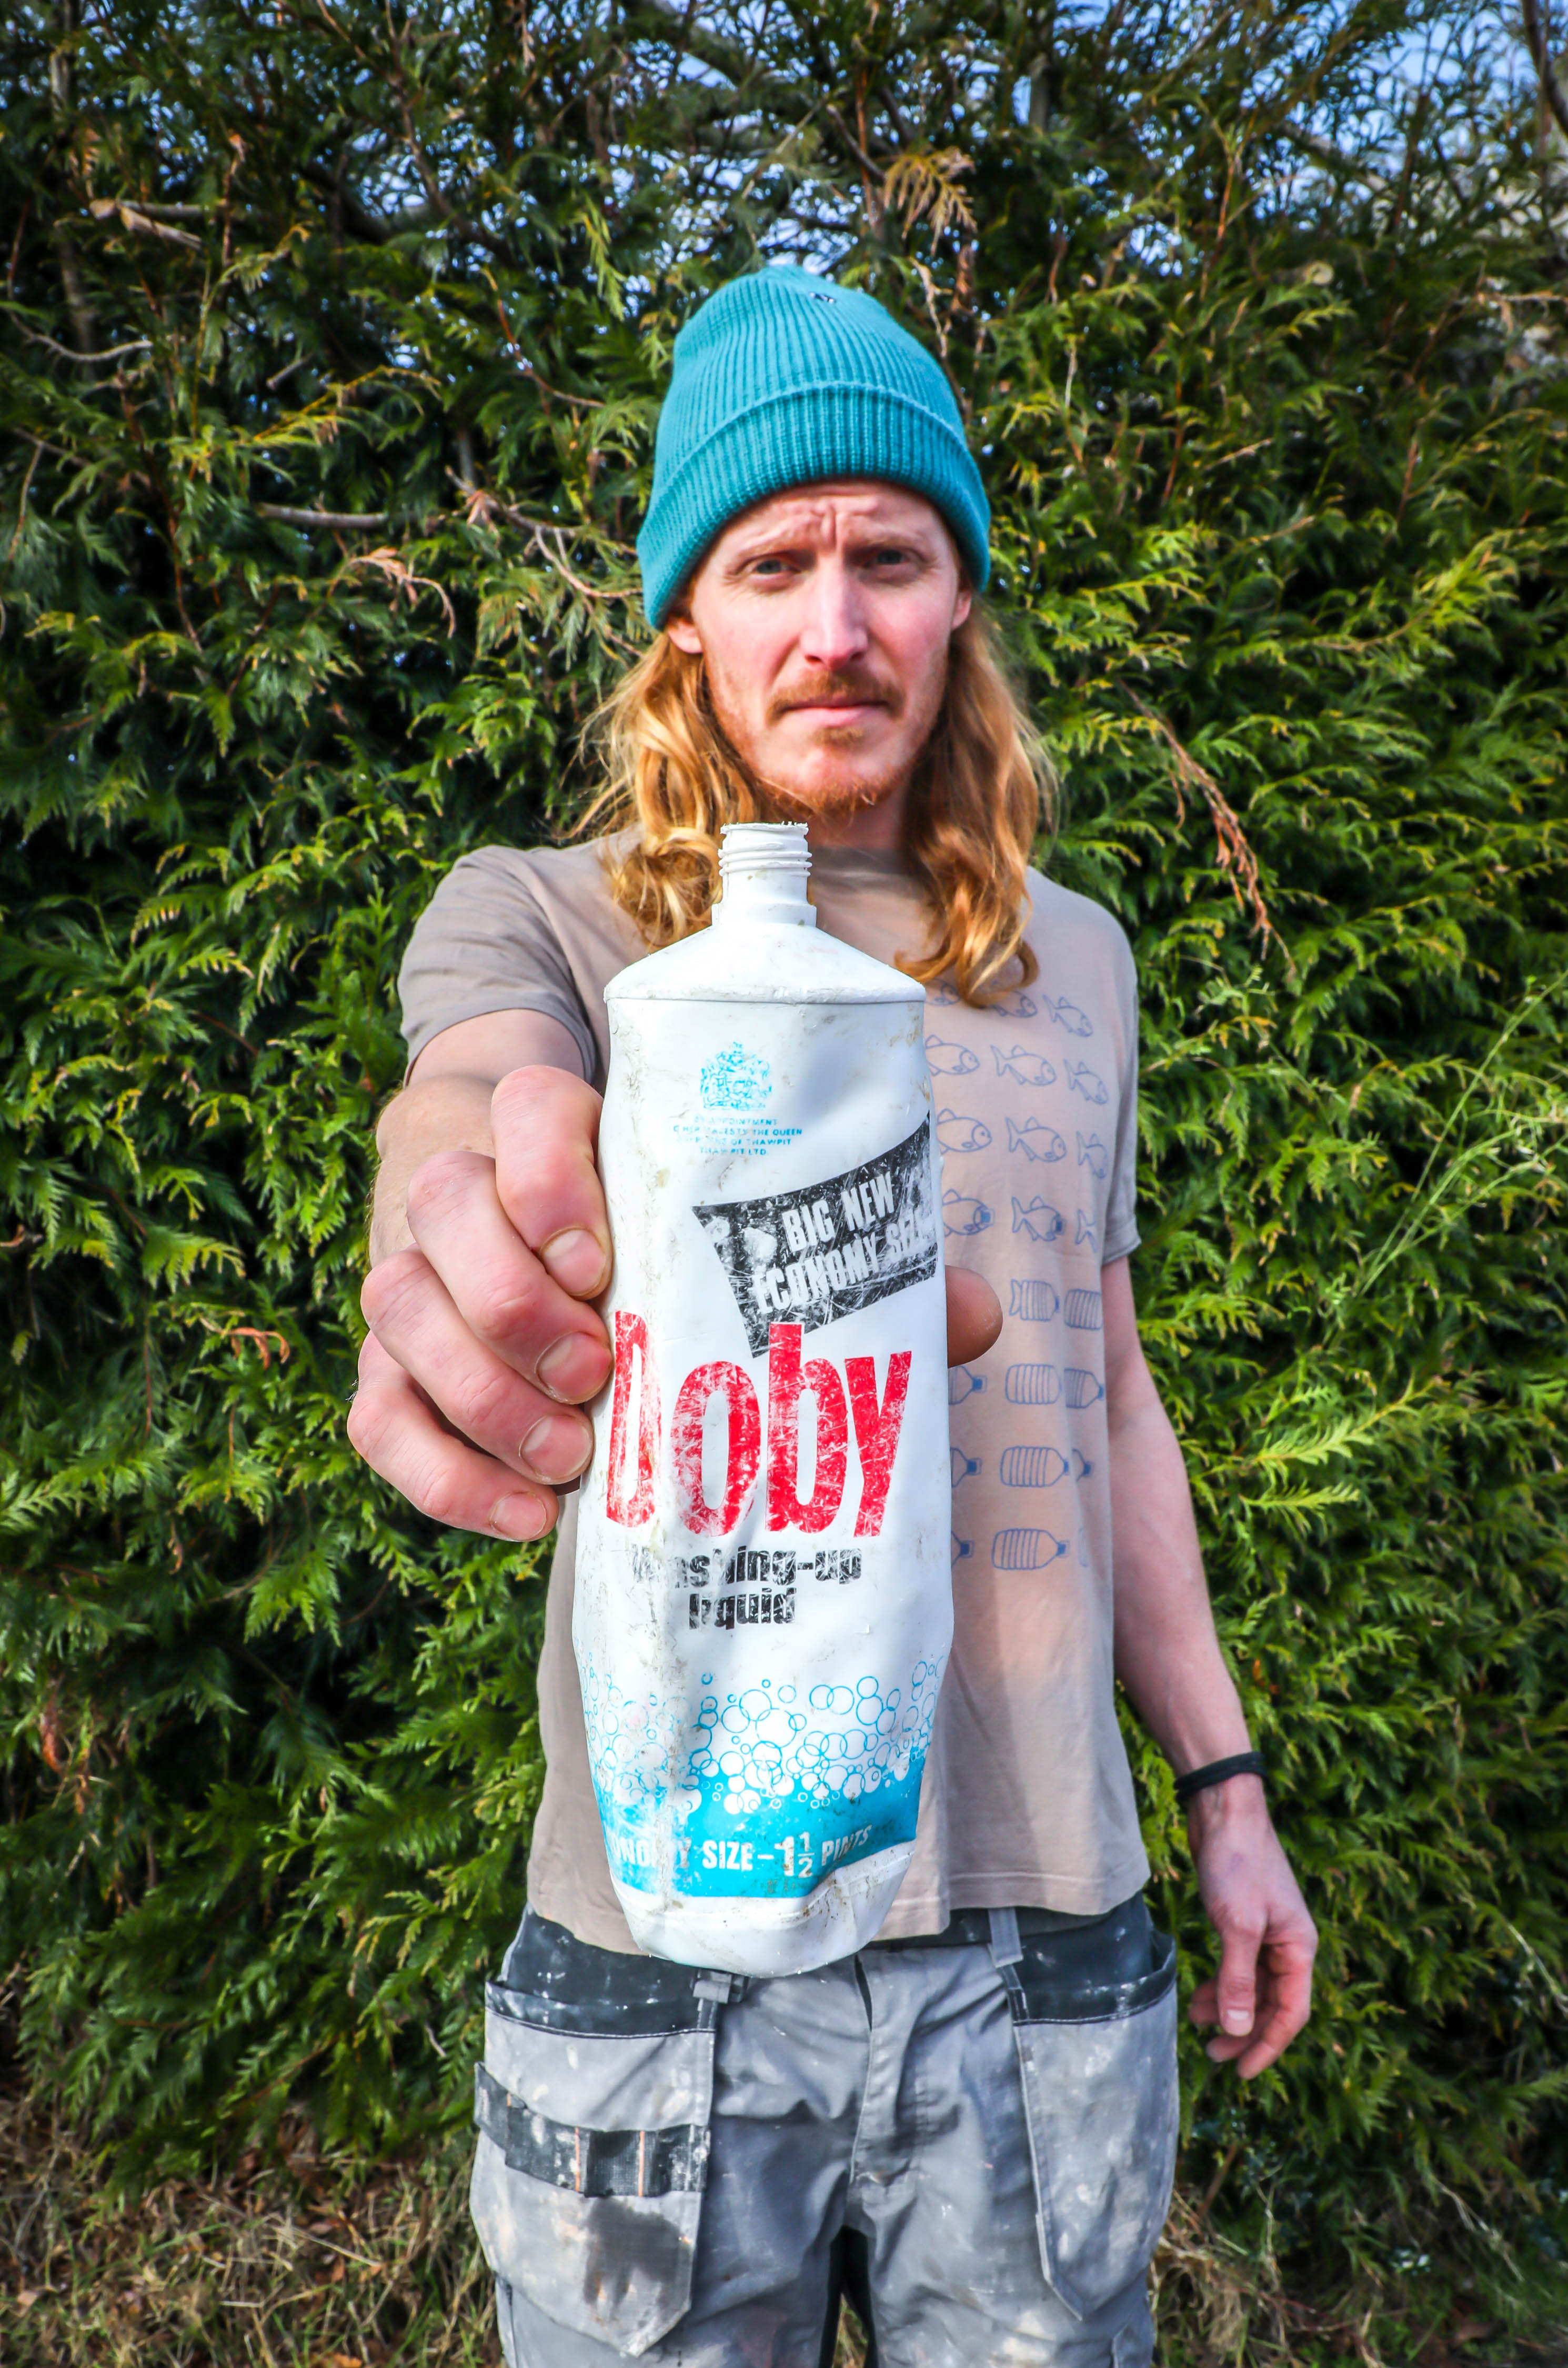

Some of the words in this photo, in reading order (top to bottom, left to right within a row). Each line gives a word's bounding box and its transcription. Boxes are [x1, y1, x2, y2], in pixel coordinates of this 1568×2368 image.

[706, 1127, 748, 1136] AJESTY
[772, 1127, 802, 1136] QUEEN
[782, 1199, 836, 1252] BIG
[843, 1171, 895, 1231] NEW
[606, 1310, 912, 1537] Doby
[821, 1824, 873, 1867] PINTS
